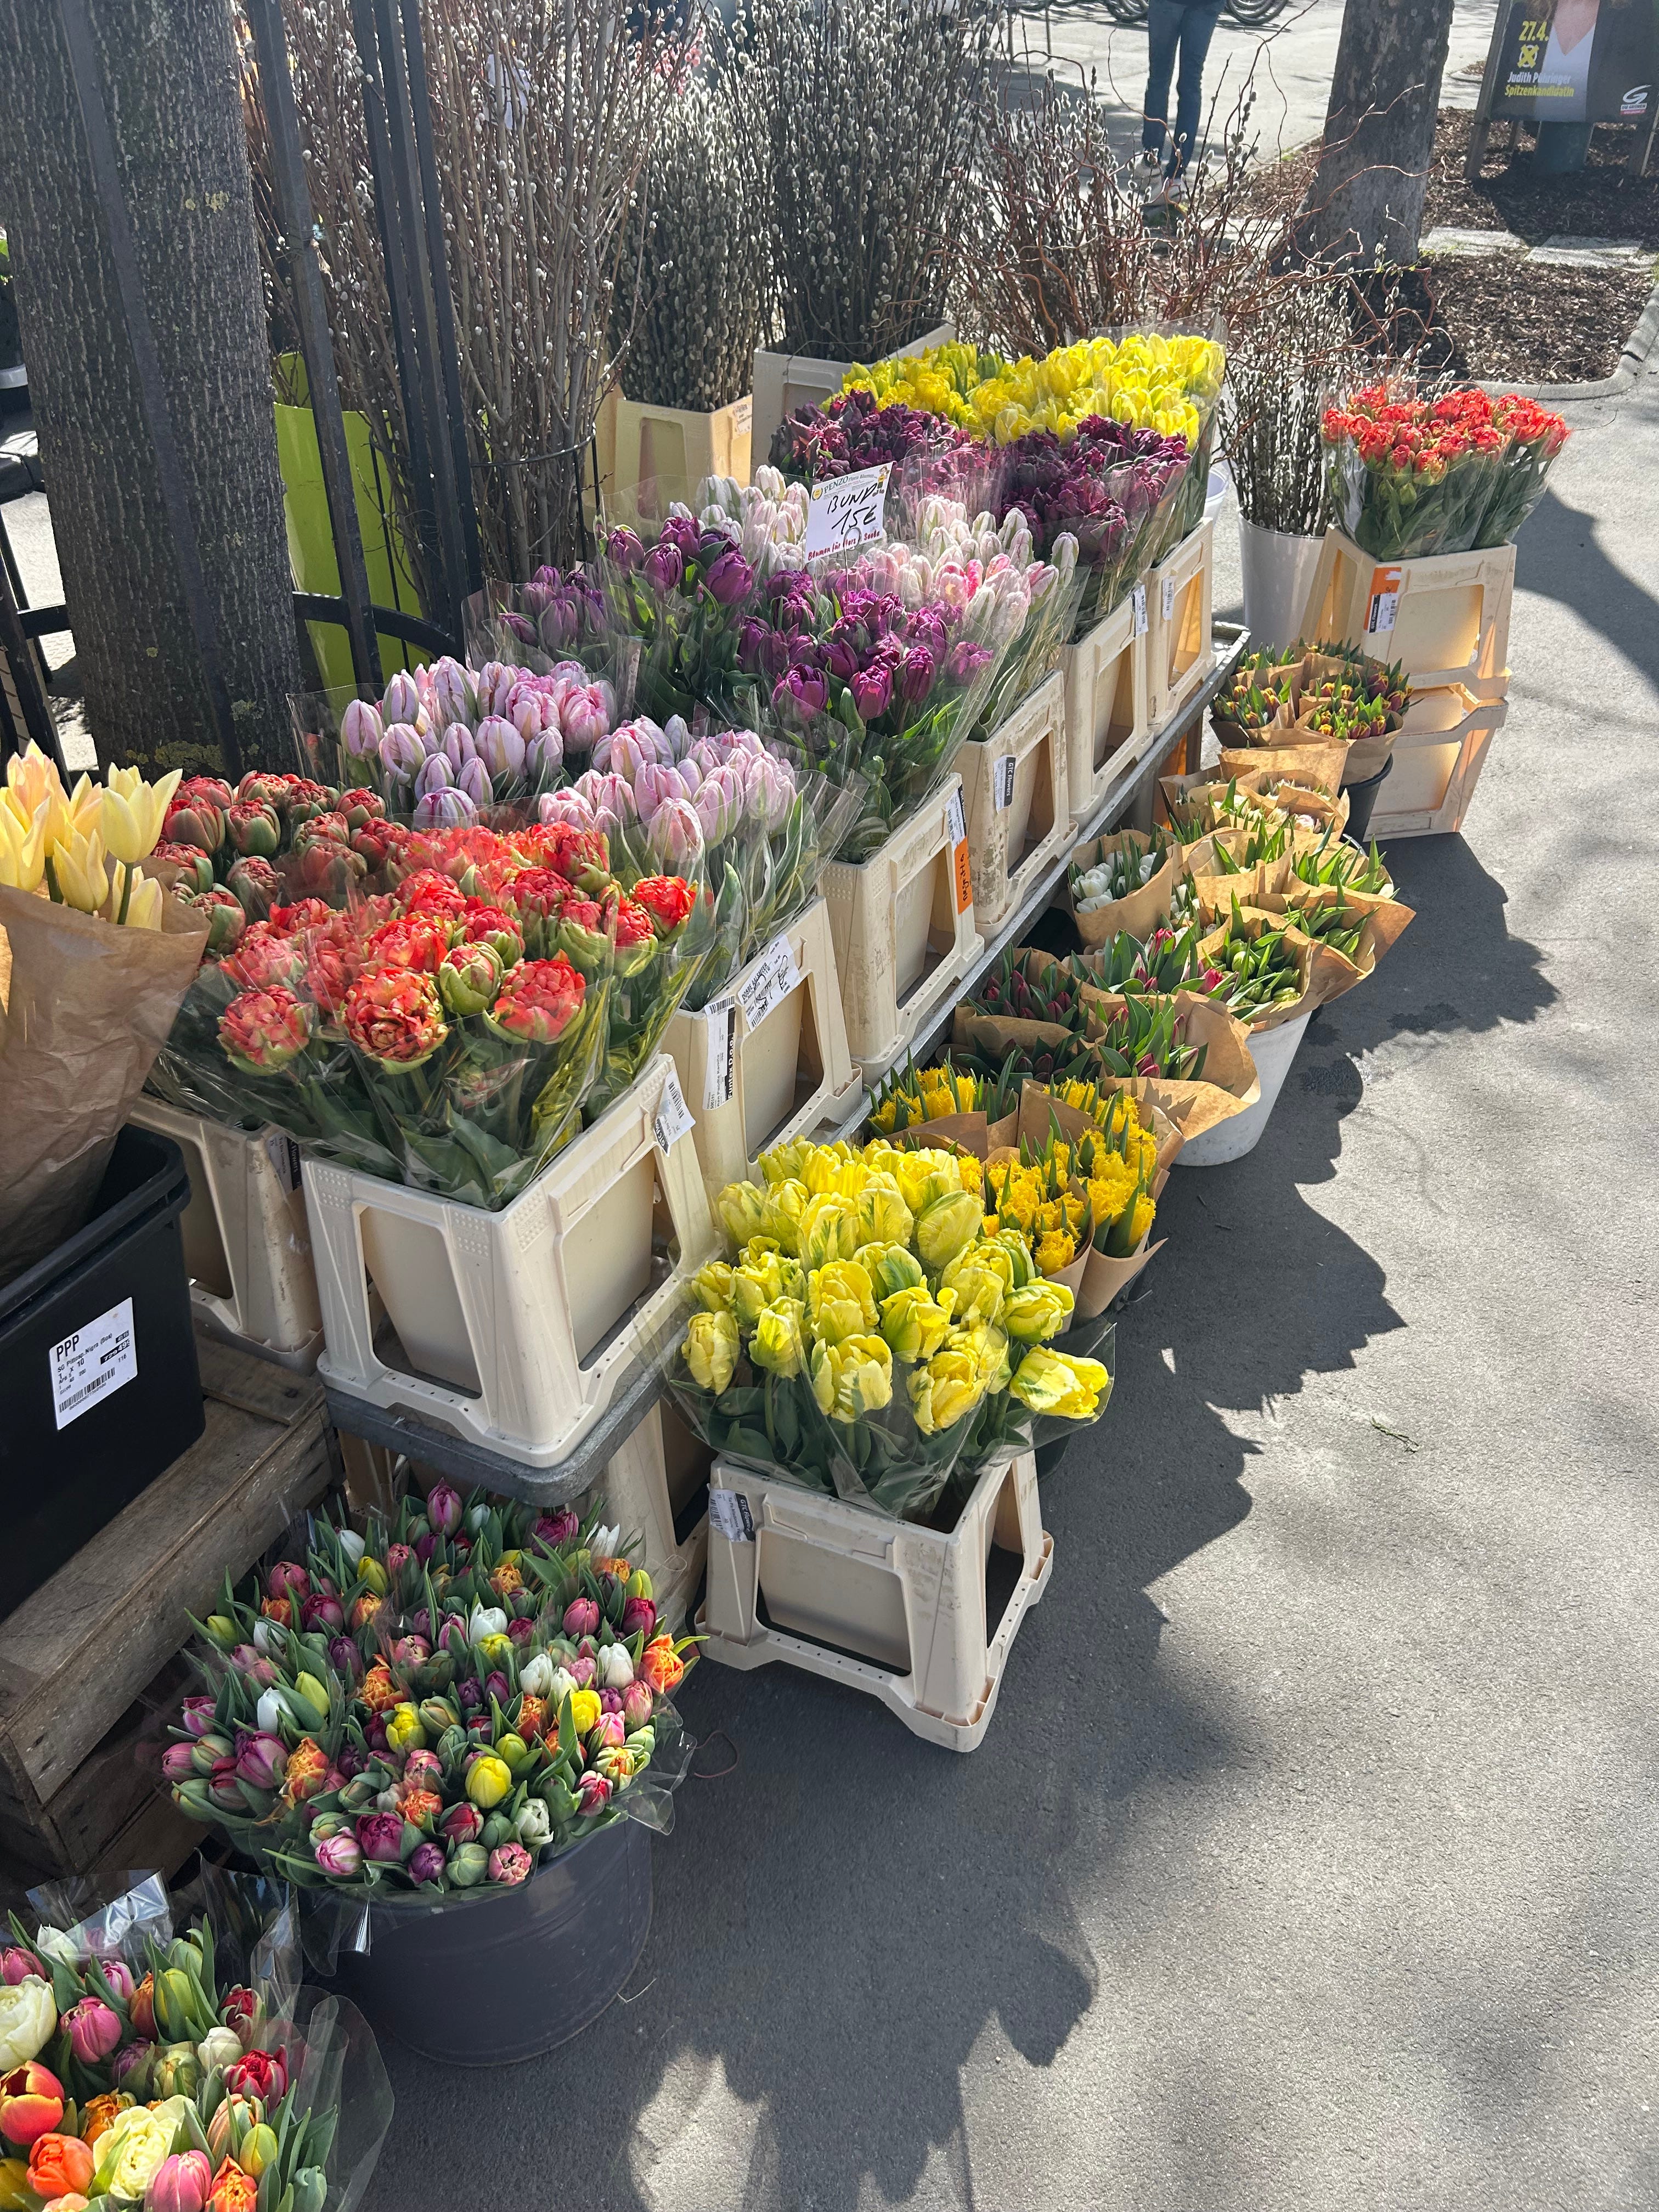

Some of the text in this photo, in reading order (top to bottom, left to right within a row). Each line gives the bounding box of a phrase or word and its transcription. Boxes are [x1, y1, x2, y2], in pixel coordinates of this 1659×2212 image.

[1519, 21, 1549, 41] 27.4.
[1508, 71, 1532, 83] Judith
[1505, 84, 1575, 97] Spitzenkandidatin
[824, 476, 849, 493] PENZO
[827, 483, 878, 515] BUND
[808, 547, 831, 561] Blumen
[832, 541, 841, 552] für
[57, 1334, 80, 1362] PPP
[77, 1358, 84, 1367] 10
